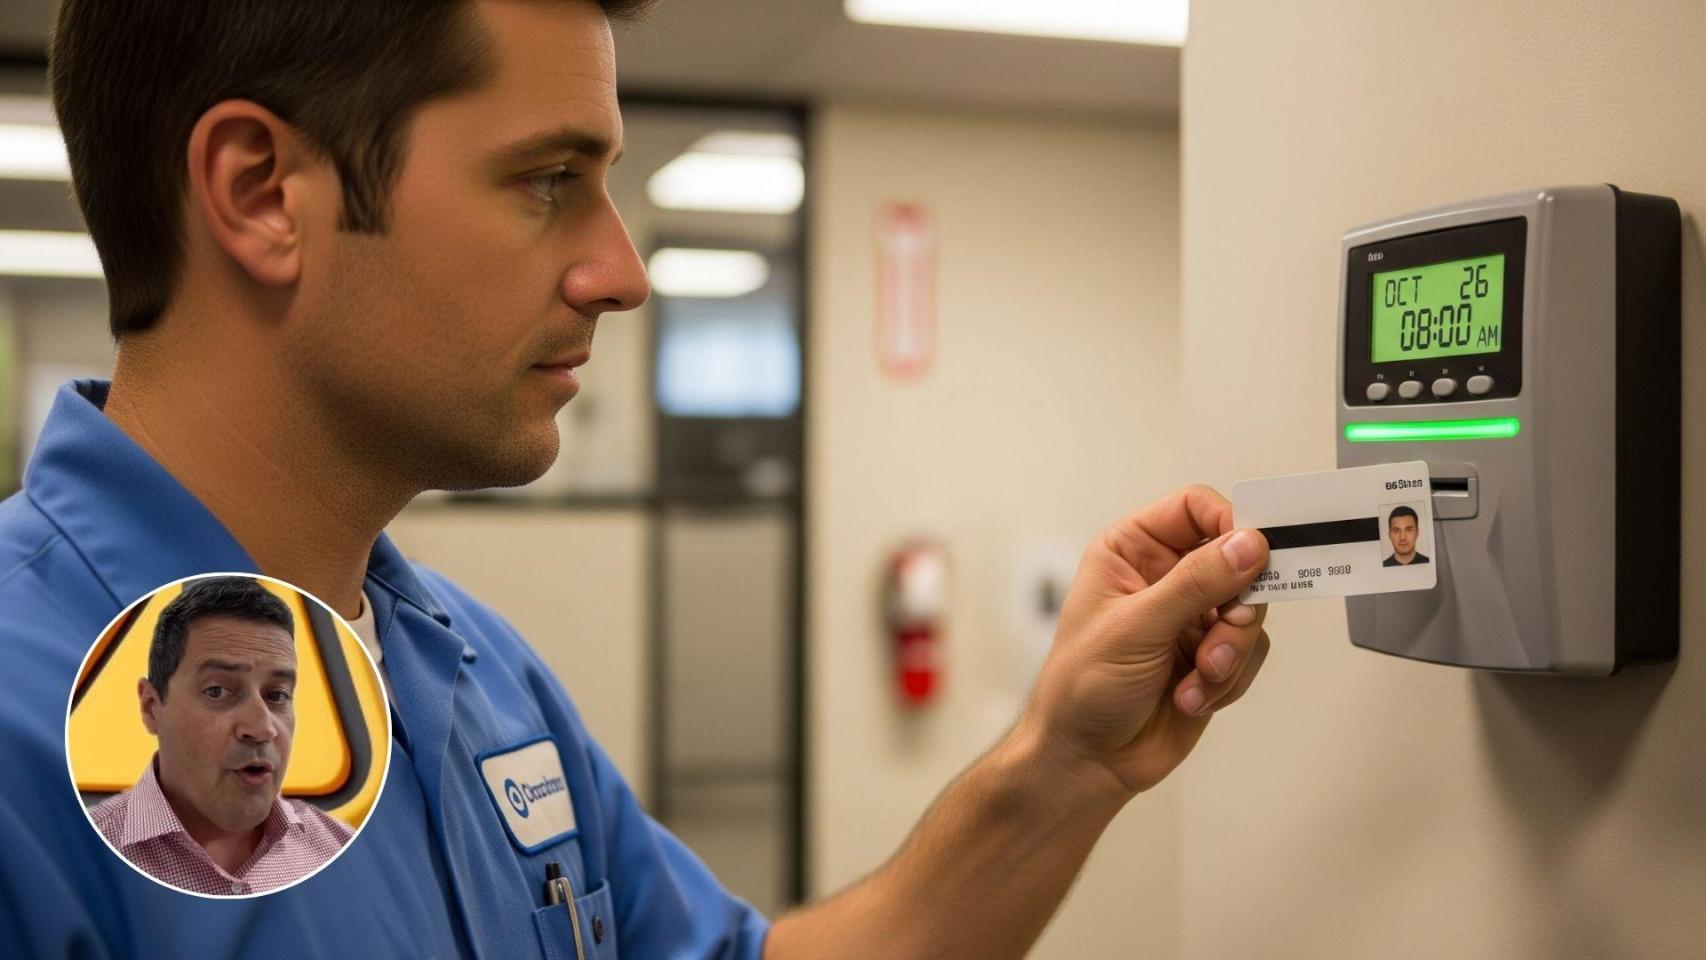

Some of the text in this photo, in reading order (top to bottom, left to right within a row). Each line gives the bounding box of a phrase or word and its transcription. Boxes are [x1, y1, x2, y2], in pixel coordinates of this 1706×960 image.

[1385, 264, 1489, 308] OCT 26
[1400, 303, 1498, 352] 08:00 AM
